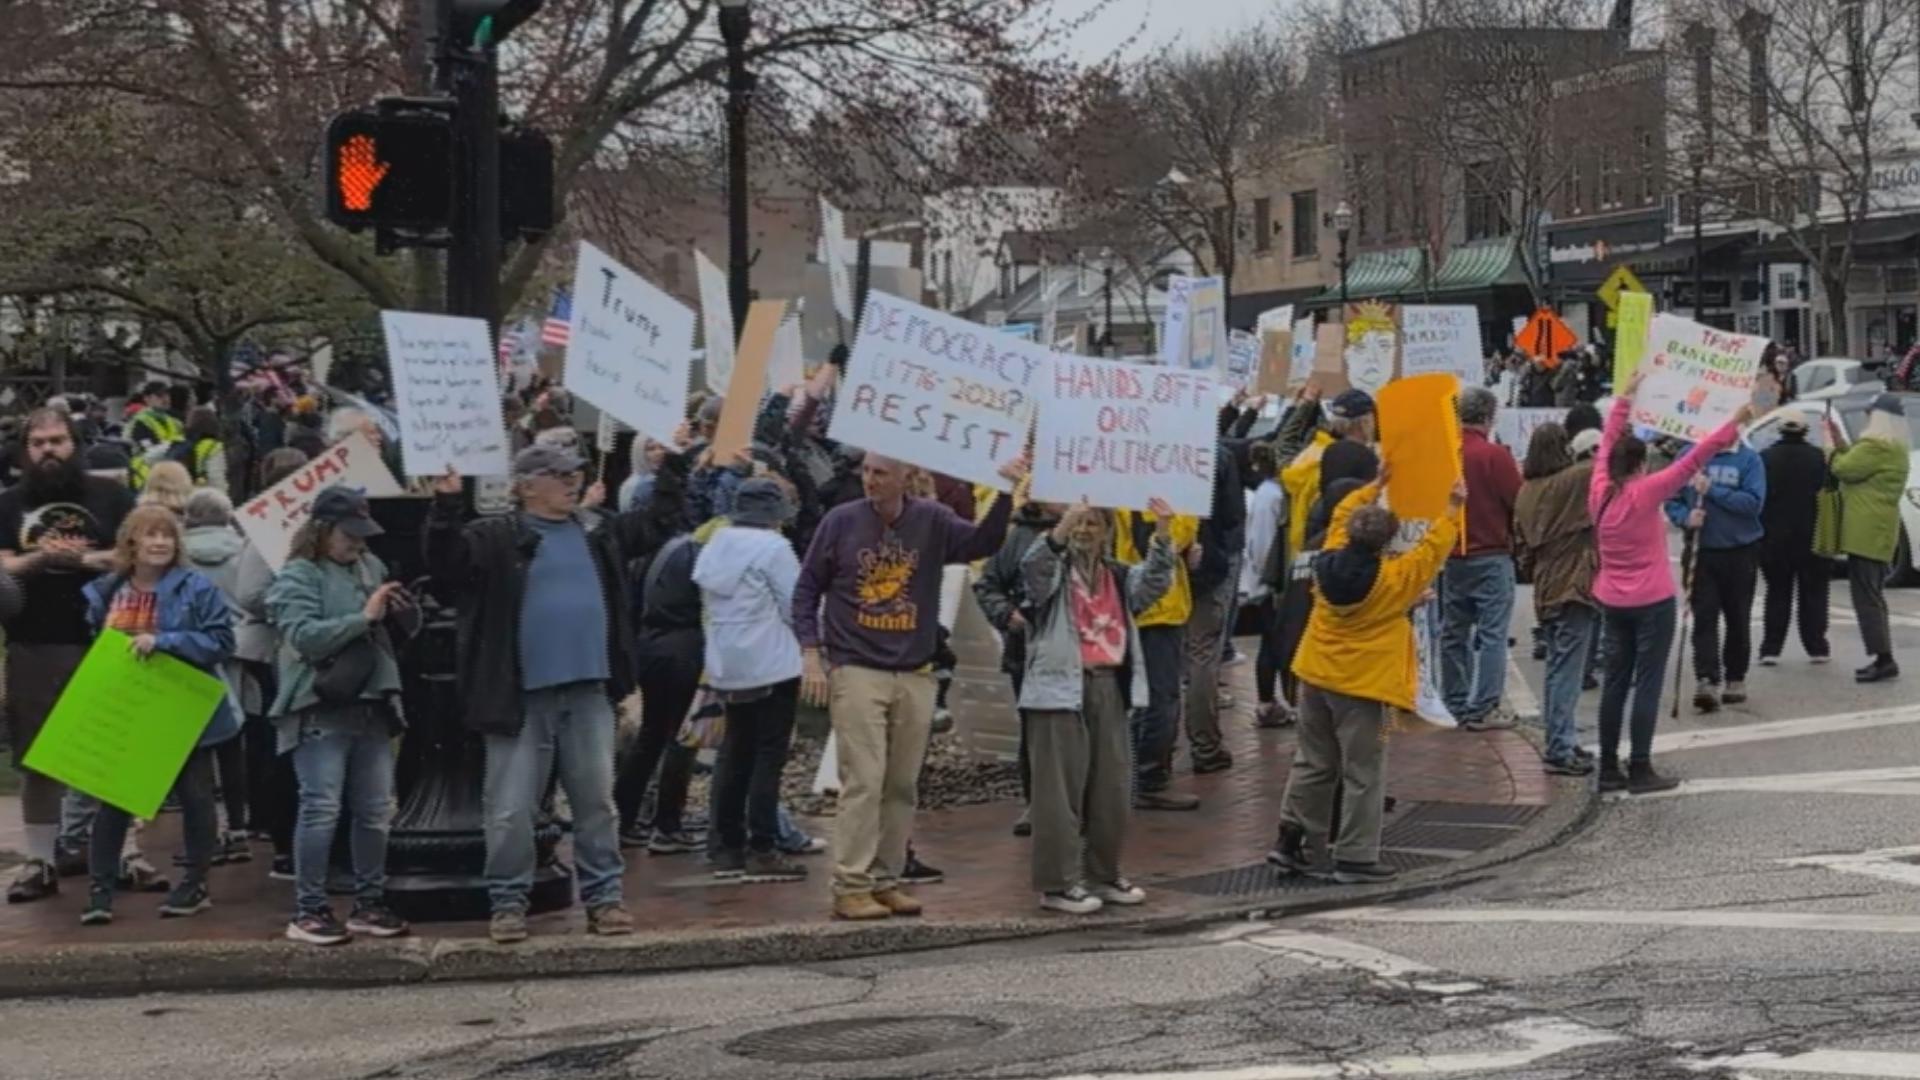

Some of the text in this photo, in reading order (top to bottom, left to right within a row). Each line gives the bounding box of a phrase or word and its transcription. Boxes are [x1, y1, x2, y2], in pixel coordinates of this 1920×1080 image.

[865, 301, 1040, 386] DEMOCRACY
[1054, 363, 1211, 408] HANDS OFF
[851, 383, 1012, 461] RESIST
[1097, 405, 1150, 434] OUR
[246, 447, 349, 519] TRUMP
[1053, 435, 1211, 481] HEALTHCARE
